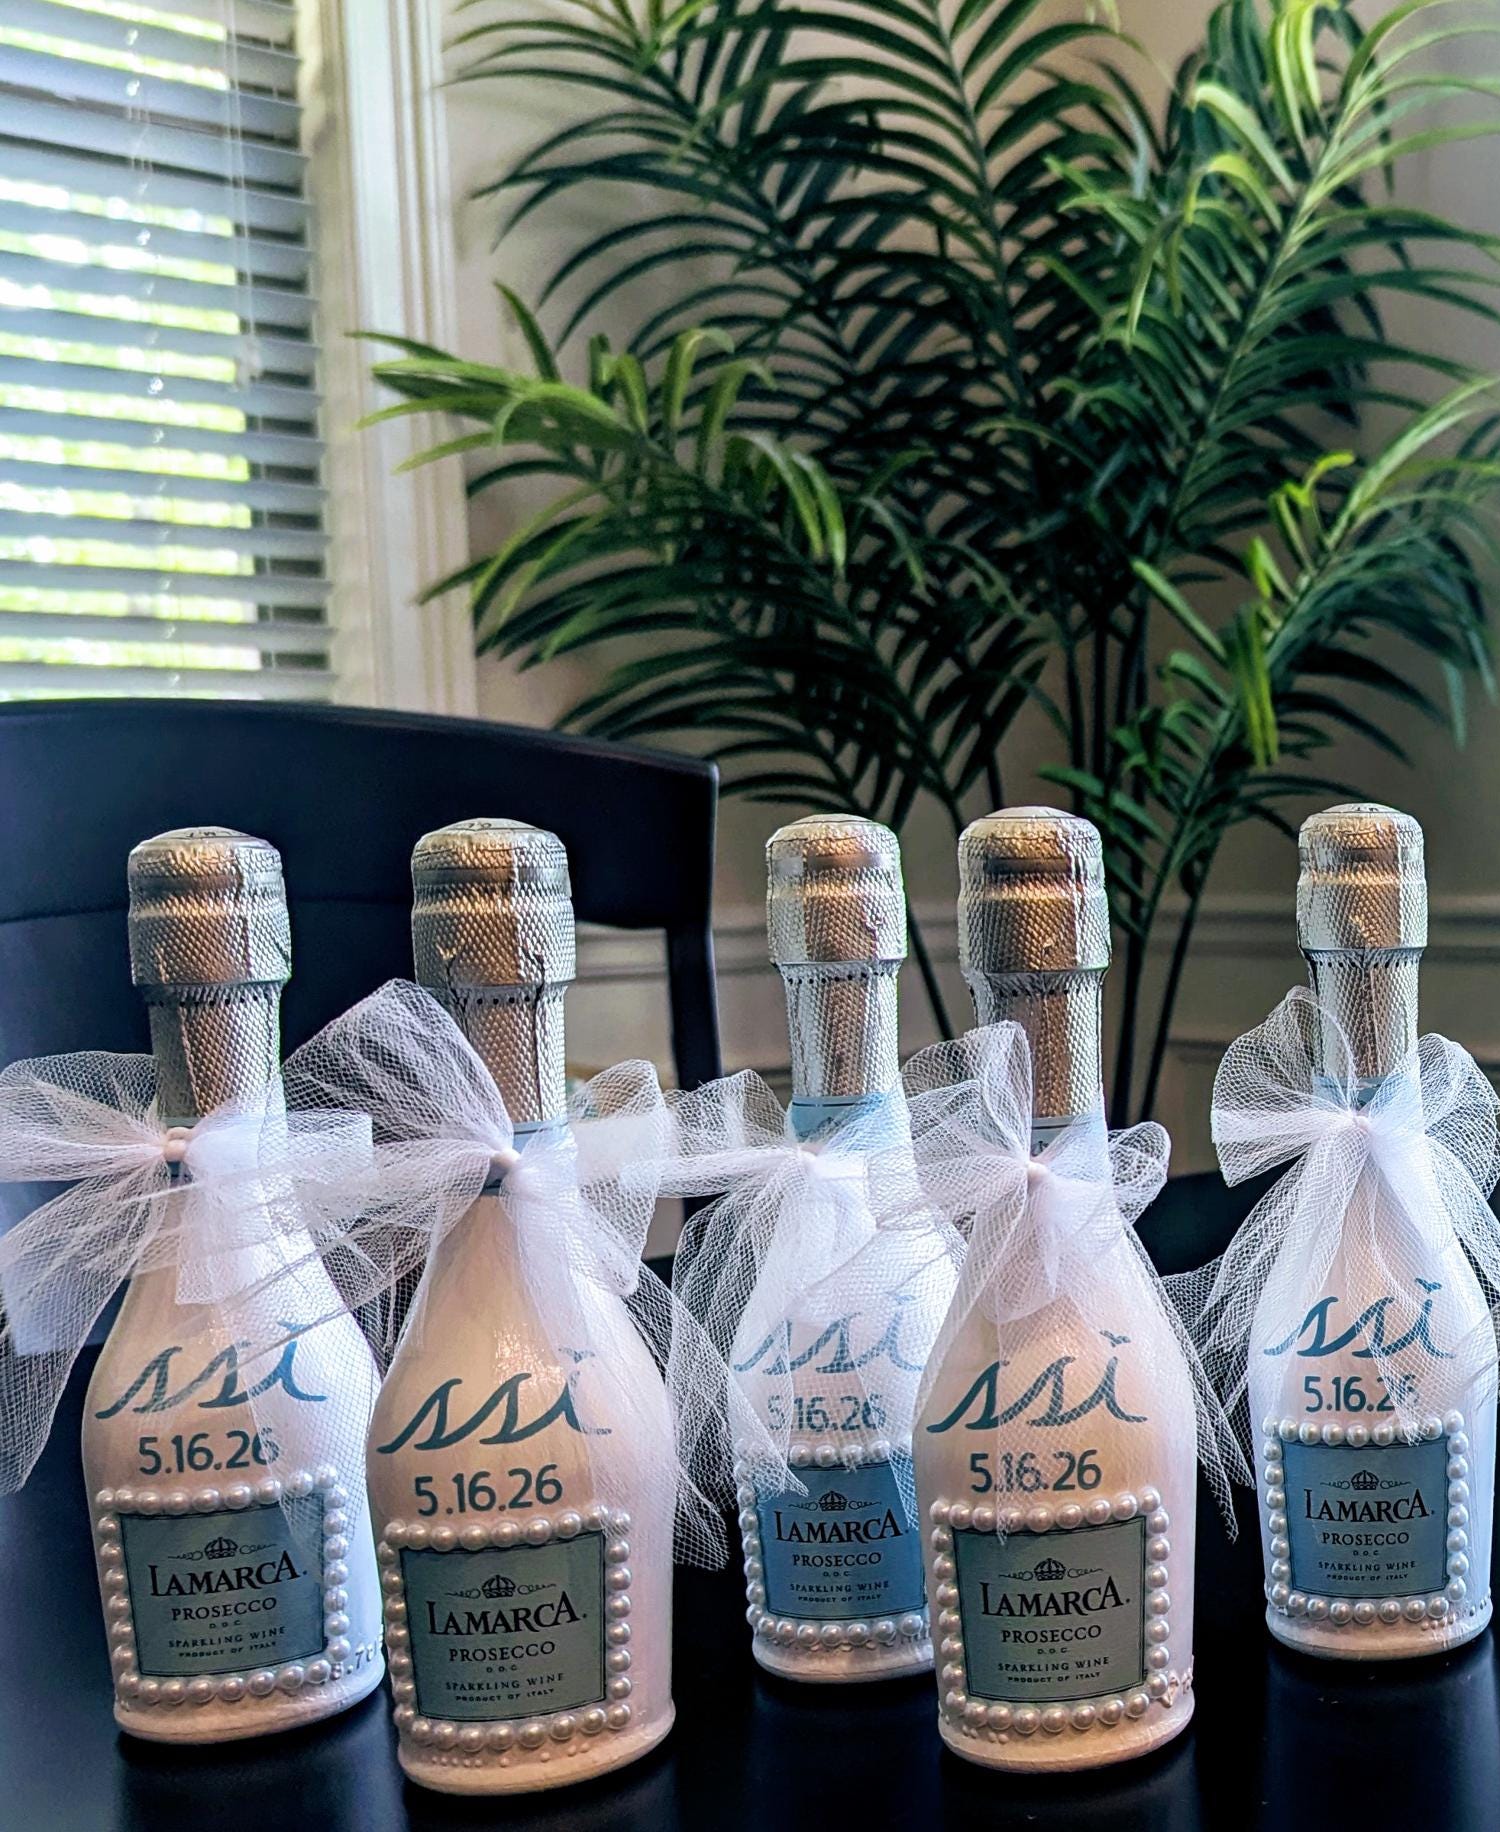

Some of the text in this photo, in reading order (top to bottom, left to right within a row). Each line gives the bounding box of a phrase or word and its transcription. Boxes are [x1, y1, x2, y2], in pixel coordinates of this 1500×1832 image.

[138, 1427, 280, 1475] 5.16.26
[970, 1449, 1102, 1493] 5.16.26
[414, 1463, 563, 1516] 5.16.26
[1322, 1532, 1409, 1546] PROSECCO
[793, 1552, 882, 1567] PROSECCO
[1318, 1561, 1416, 1571] SPARKLING WINE
[791, 1581, 889, 1592] SPARKLING WINE
[172, 1597, 277, 1620] PROSECCO
[169, 1627, 285, 1648] SPARKLING WINE
[1002, 1625, 1101, 1644] PROSECCO
[449, 1641, 555, 1662] PROSECCO
[998, 1657, 1110, 1671] SPARKLING WINE
[446, 1673, 564, 1691] SPARKLING WINE
